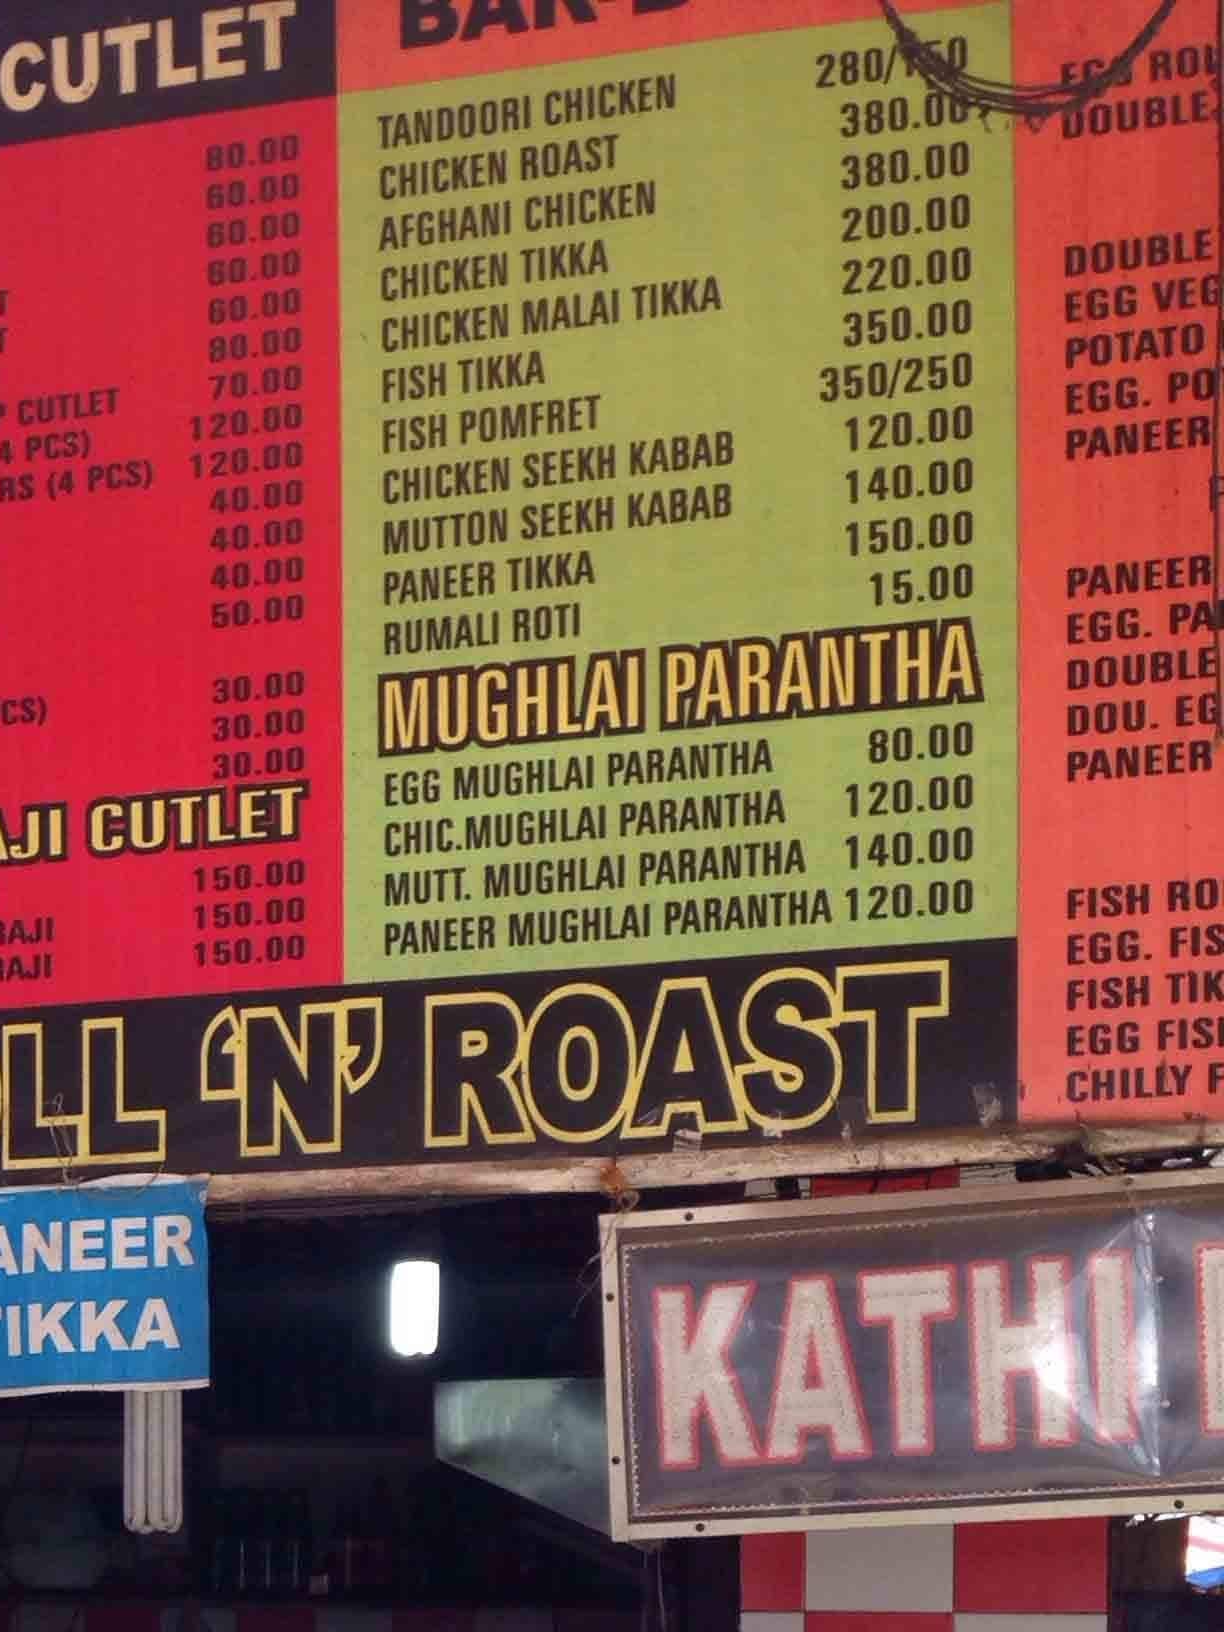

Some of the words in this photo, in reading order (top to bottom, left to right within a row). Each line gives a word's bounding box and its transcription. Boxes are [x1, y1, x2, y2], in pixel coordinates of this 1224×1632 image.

[0, 0, 296, 111] CUTLET
[377, 96, 531, 149] TANDOORI
[544, 74, 675, 126] CHICKEN
[1061, 90, 1209, 138] DOUBLE
[206, 134, 300, 171] 80.00
[380, 150, 506, 200] CHICKEN
[520, 134, 619, 181] ROAST
[379, 200, 511, 251] AFGHANI
[525, 180, 655, 232] CHICKEN
[842, 194, 970, 242] 200.00
[1065, 228, 1212, 277] DOUBLE
[382, 304, 508, 352] CHICKEN
[522, 289, 619, 335] MALAI
[632, 276, 721, 320] TIKKA
[1066, 285, 1137, 322] EGG
[1066, 323, 1205, 368] POTATO
[18, 387, 119, 426] CUTLET
[383, 414, 446, 454] FISH
[460, 395, 600, 444] POMFRET
[820, 352, 972, 402] 350/250
[1066, 377, 1150, 414] EGG.
[26, 430, 90, 461] PCS)
[193, 404, 303, 440] 120.00
[1066, 416, 1209, 460] PANEER
[523, 444, 616, 488] SEEKH
[630, 431, 733, 476] KABAB
[384, 508, 507, 555] MUTTON
[384, 562, 494, 605] PANEER
[506, 551, 595, 591] TIKKA
[384, 611, 498, 655] RUMALI
[513, 603, 579, 642] ROTI
[870, 564, 972, 606] 15.00
[378, 649, 646, 756] MUGHLAI
[661, 617, 984, 729] PARANTHA
[1068, 700, 1157, 736] DOU.
[385, 770, 440, 806] EGG
[454, 756, 593, 800] MUGHLAI
[608, 739, 772, 787] PARANTHA
[869, 722, 973, 763] 80.00
[87, 780, 310, 857] CUTLET
[620, 790, 785, 837] PARANTHA
[194, 859, 306, 891] 150.00
[385, 867, 470, 906] MUTT.
[1068, 884, 1149, 919] FISH
[425, 960, 950, 1147] ROAST
[1067, 1022, 1139, 1056] EGG
[1067, 1062, 1192, 1102] CHILLY
[653, 1247, 1139, 1469] KATHI
